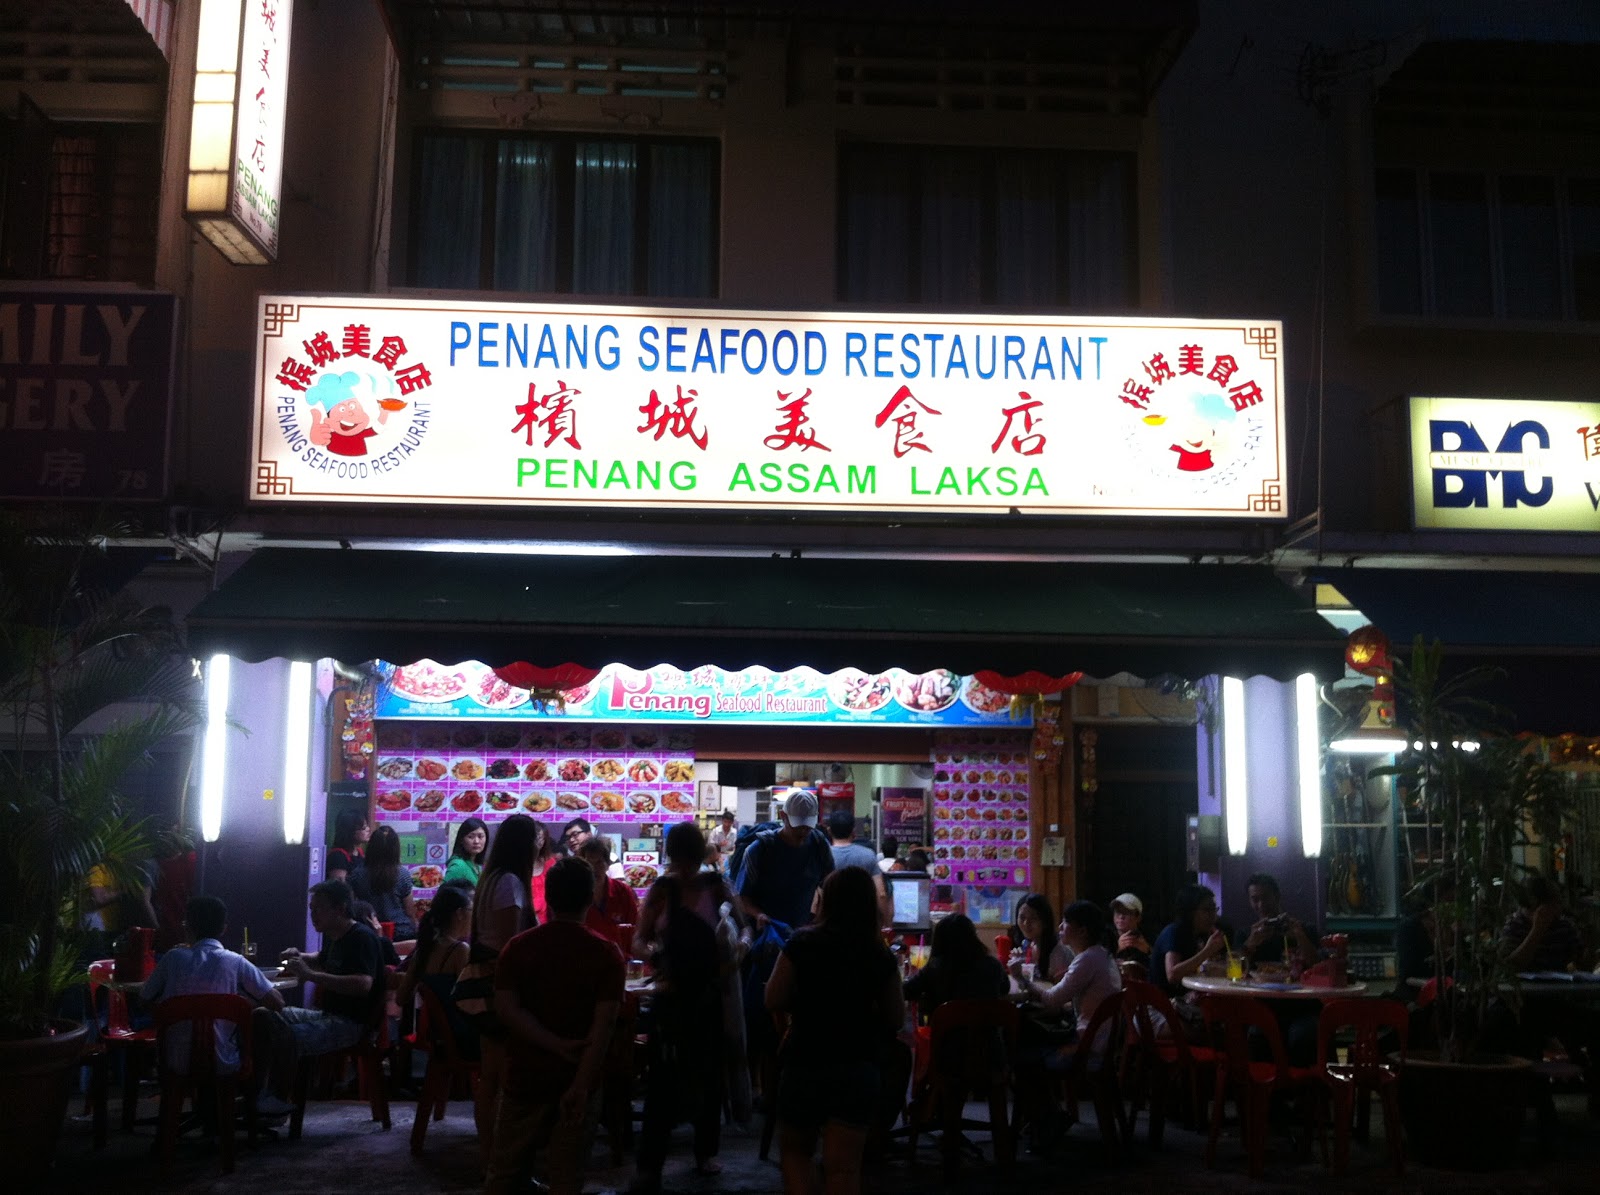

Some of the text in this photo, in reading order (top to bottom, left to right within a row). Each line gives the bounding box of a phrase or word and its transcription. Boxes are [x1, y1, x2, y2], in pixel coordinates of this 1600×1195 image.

[238, 158, 278, 217] PENANG
[450, 321, 1108, 380] PENANG SEAFOOD RESTAURANT
[0, 379, 143, 431] ERY
[511, 380, 1047, 458] 檳城美食店
[278, 395, 431, 480] PENANG SEAFOOD RESTAURANT
[1430, 420, 1553, 508] BMC
[517, 457, 1049, 496] PENANG ASSAM LAKSA
[610, 670, 712, 714] Penang
[716, 692, 761, 713] Seafood
[766, 693, 826, 714] Restaurant
[407, 843, 417, 857] B
